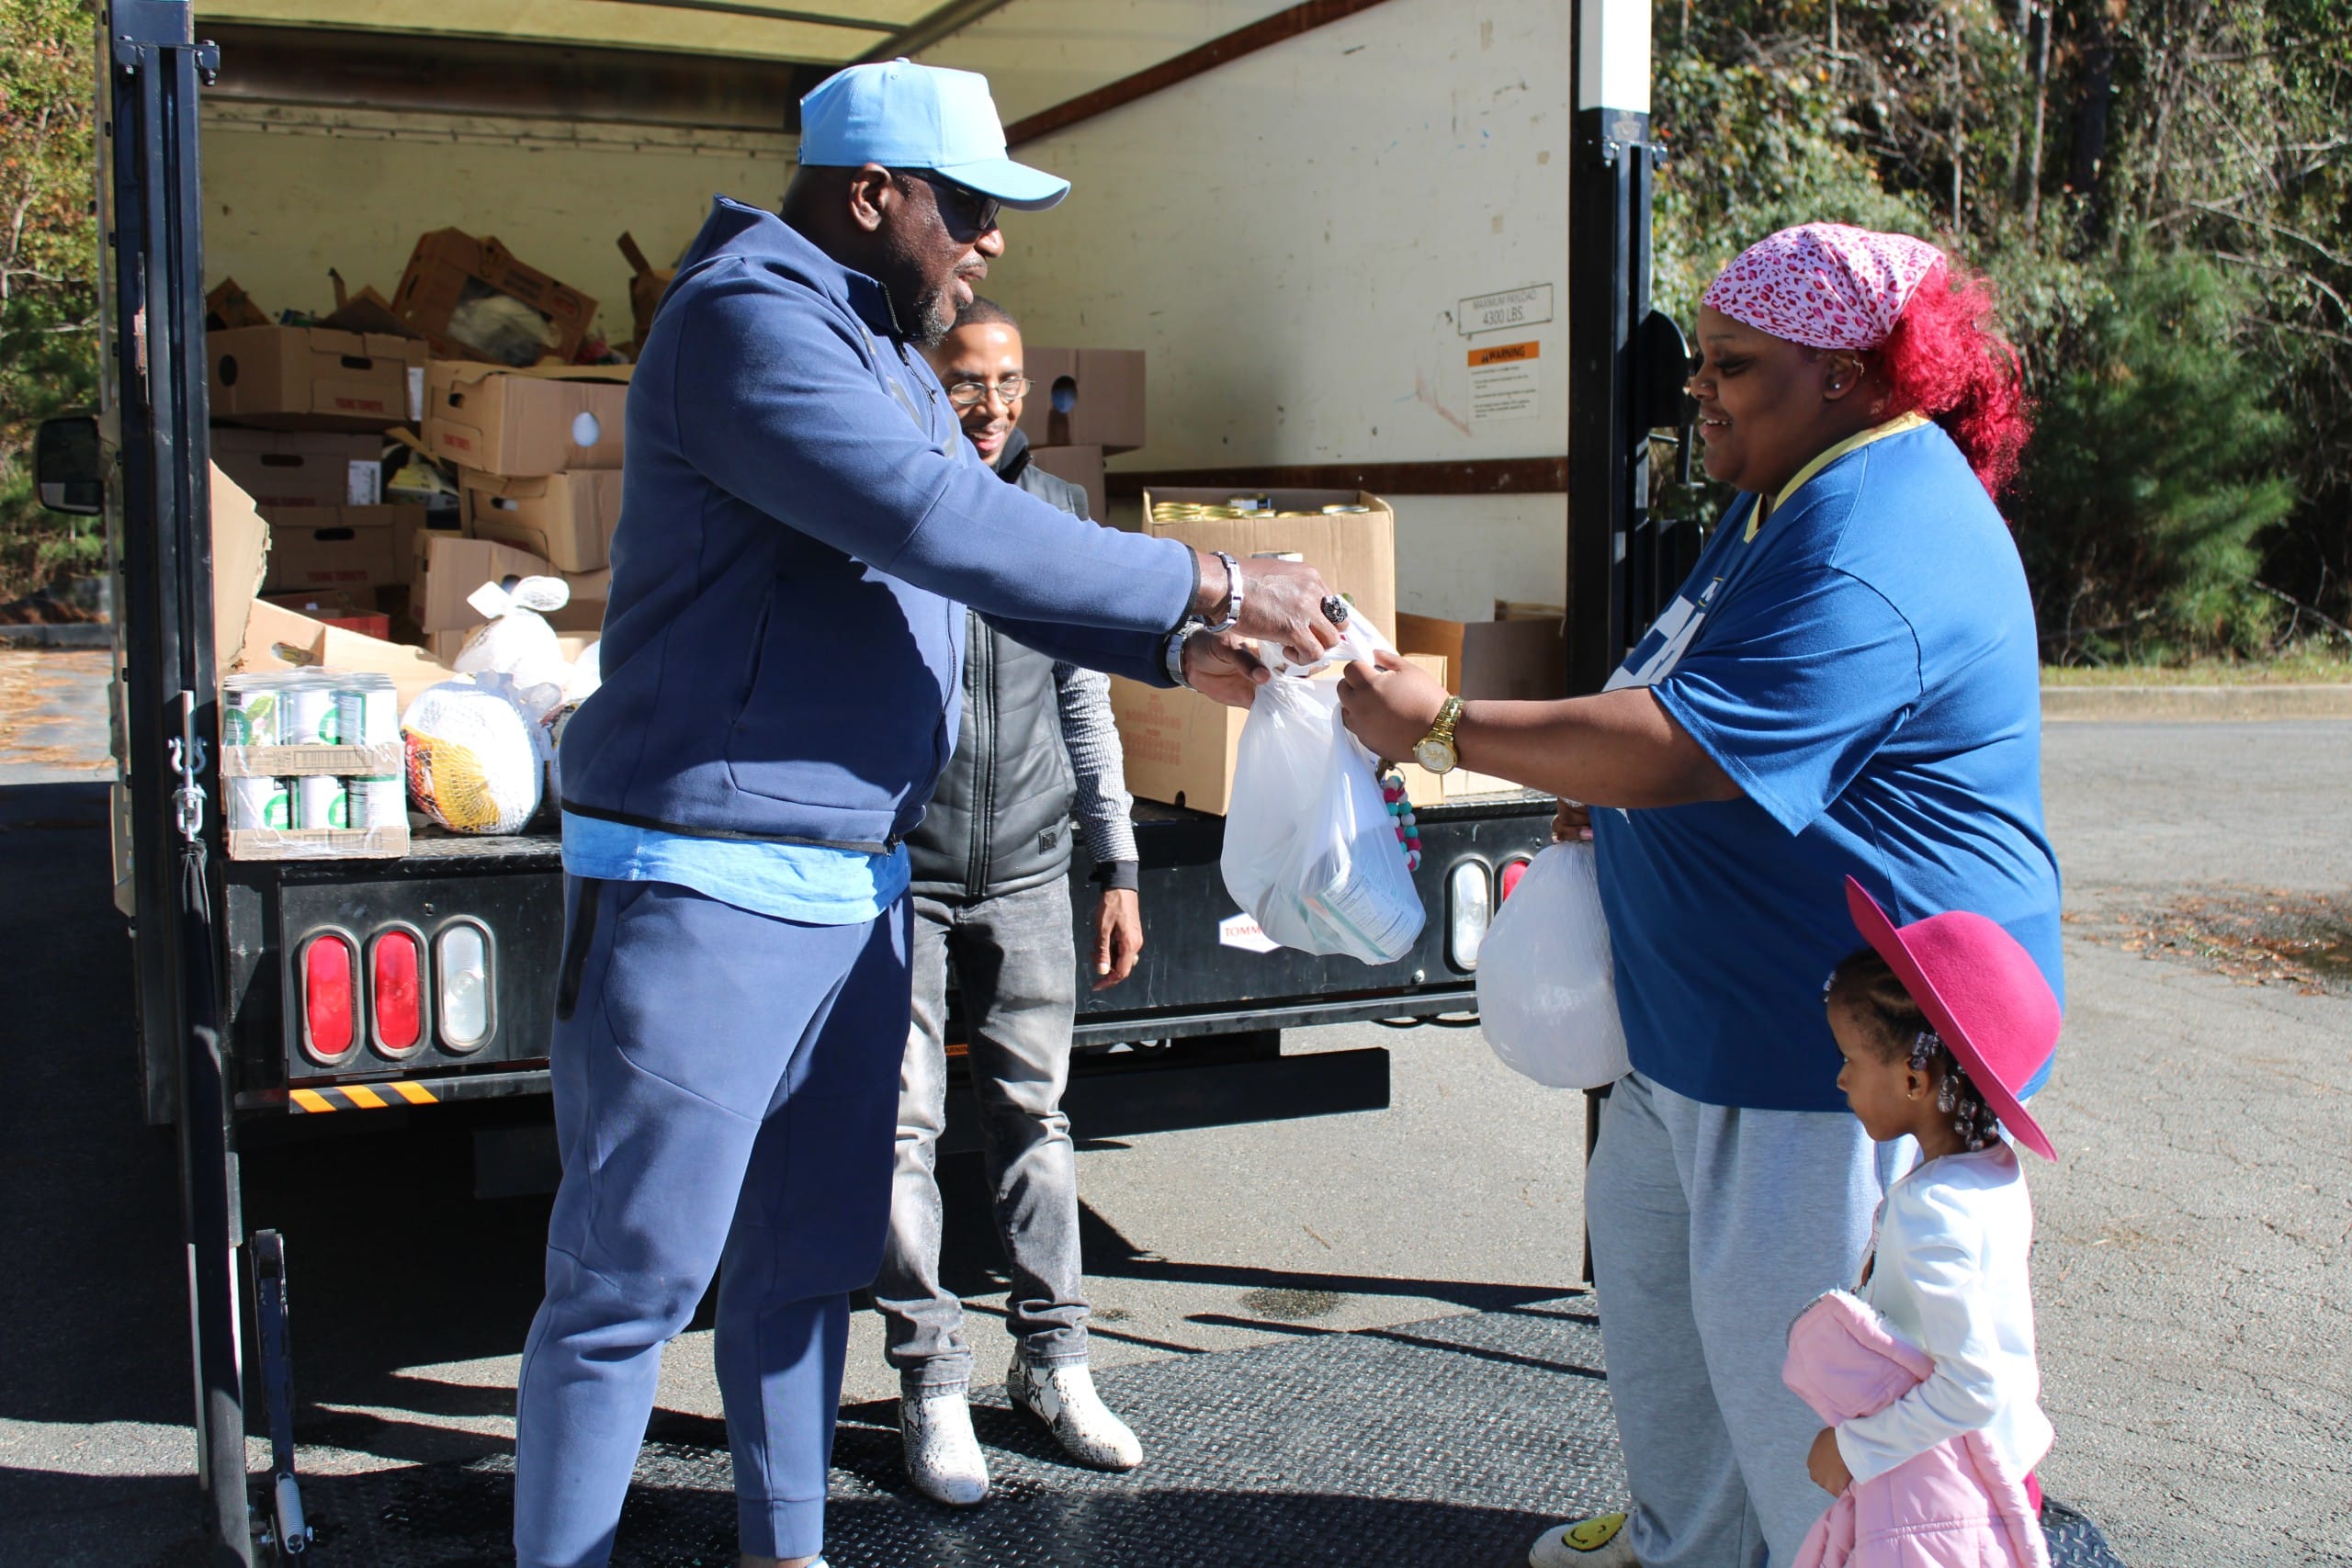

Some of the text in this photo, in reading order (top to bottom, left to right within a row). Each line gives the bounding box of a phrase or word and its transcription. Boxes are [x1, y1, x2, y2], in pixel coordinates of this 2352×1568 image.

[1474, 290, 1536, 310] MAXIMUM PAYLOAD
[1483, 310, 1506, 325] 4300
[1490, 345, 1525, 361] WARNING
